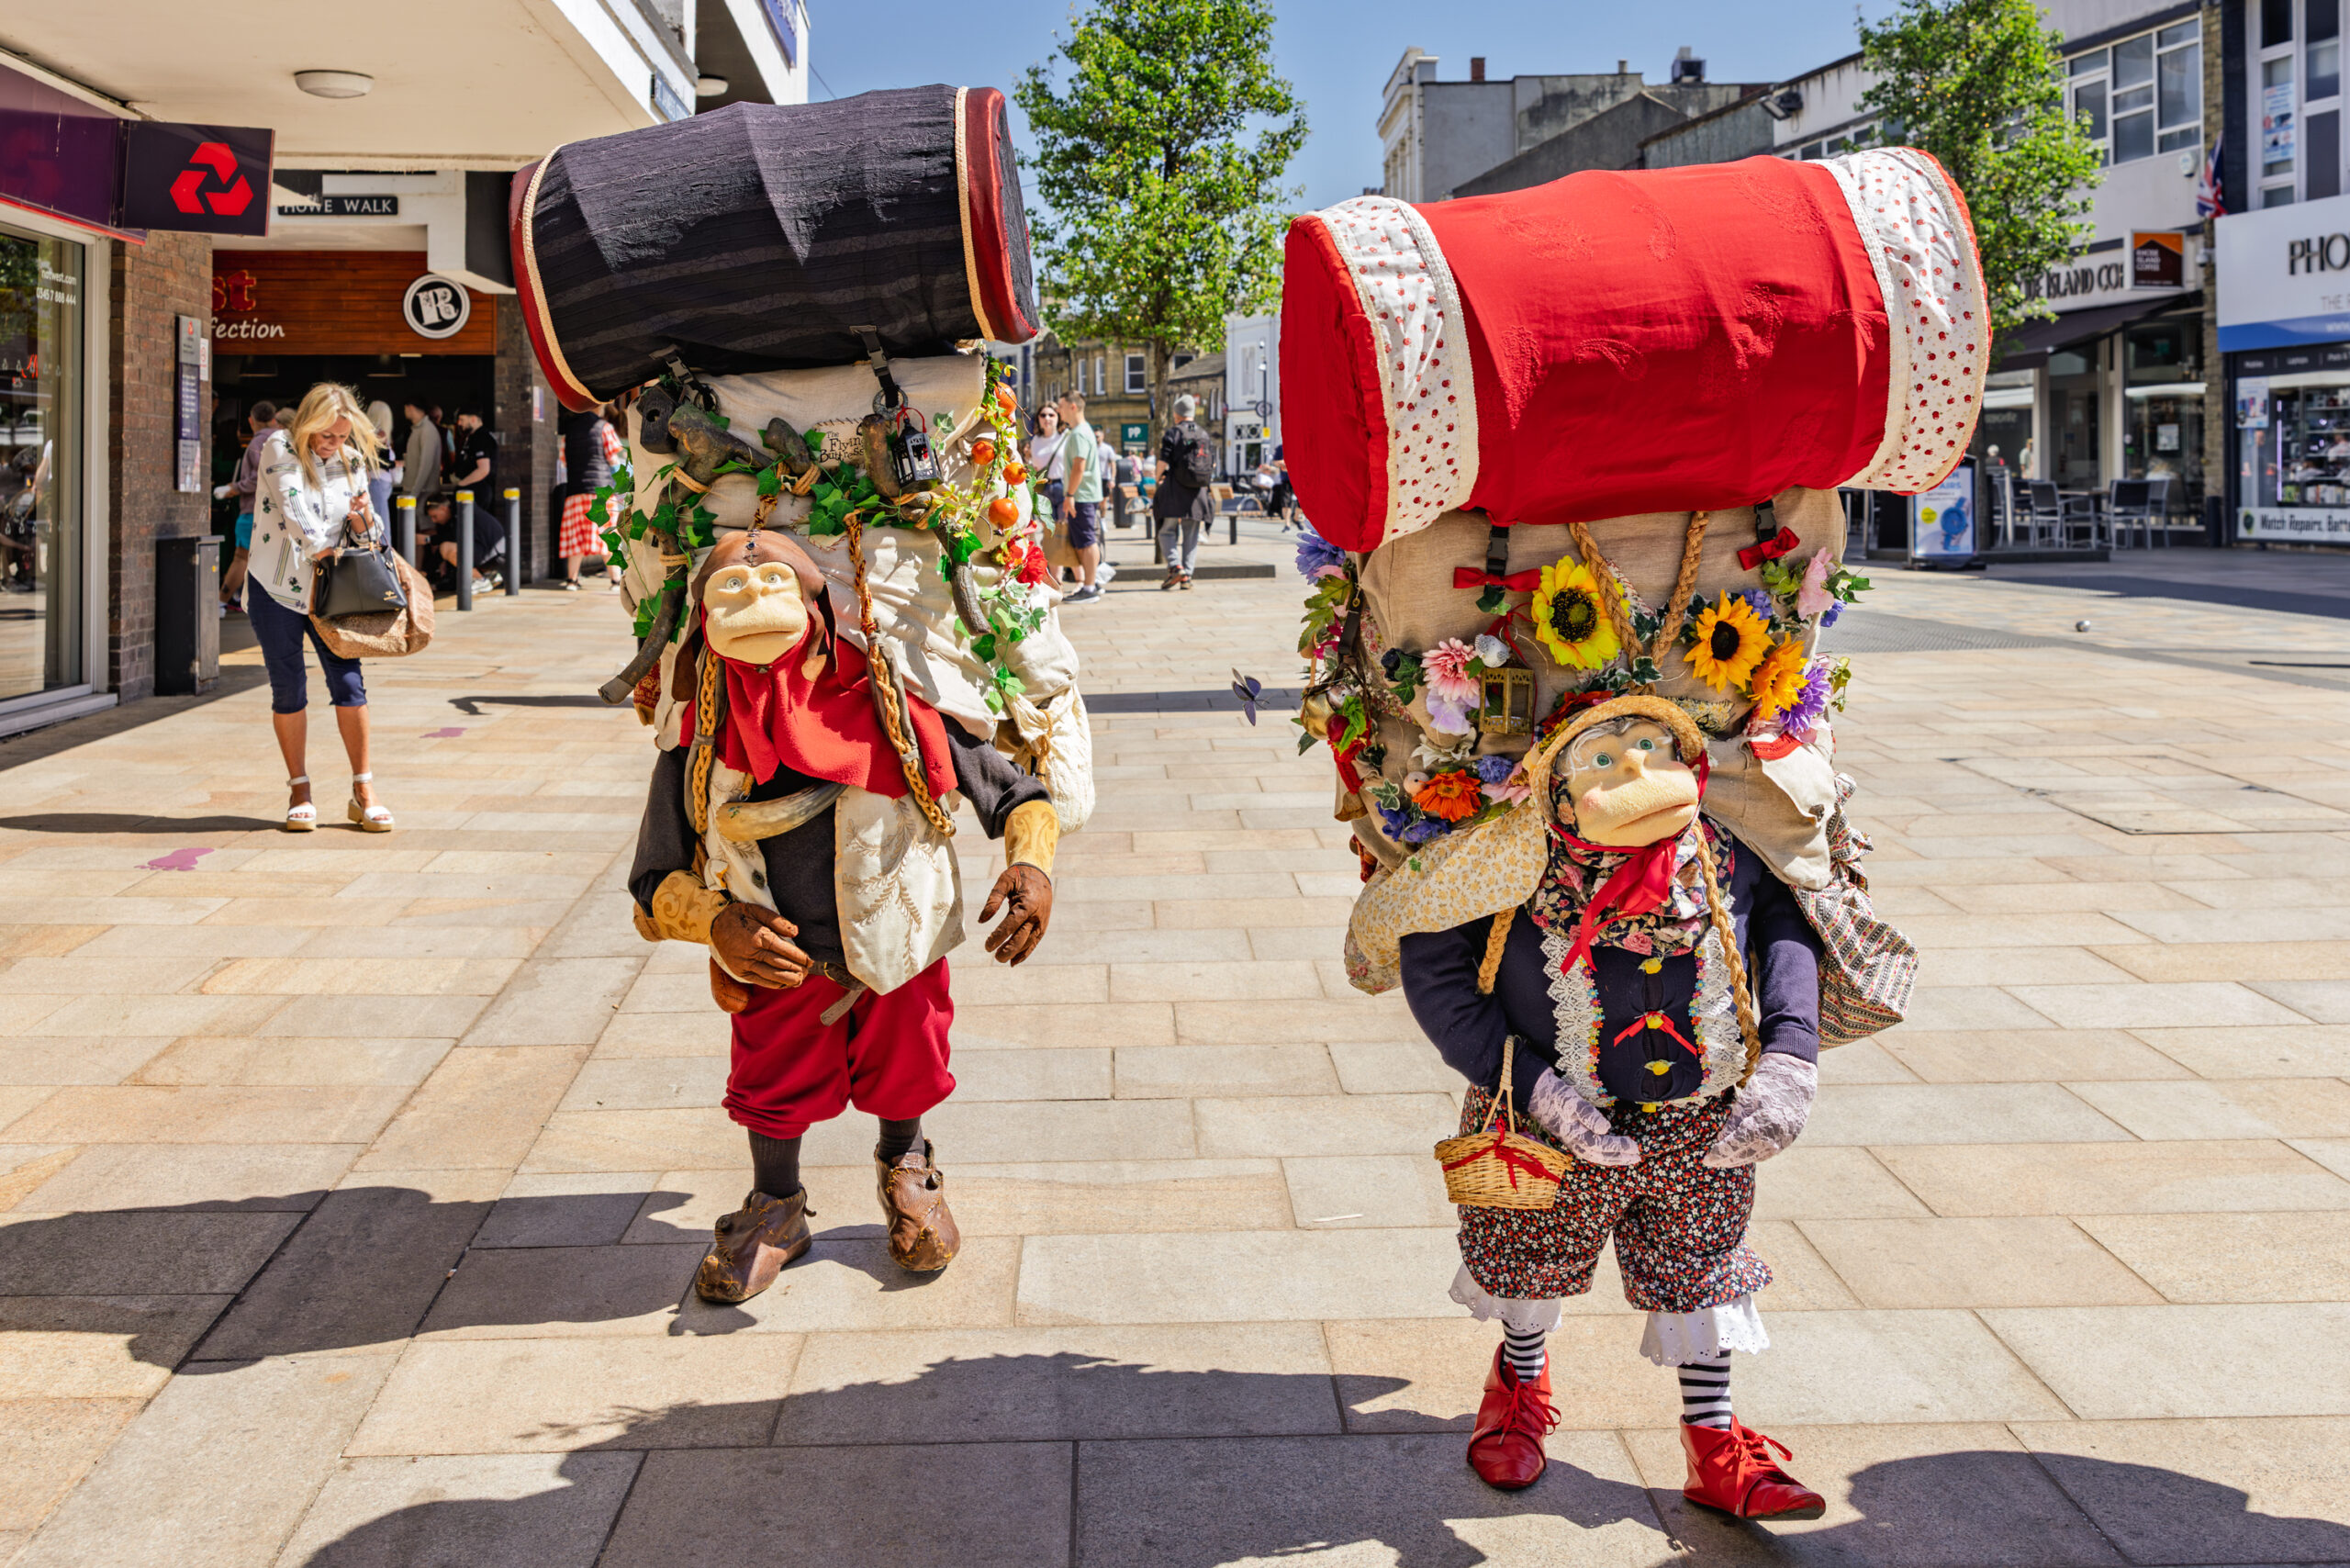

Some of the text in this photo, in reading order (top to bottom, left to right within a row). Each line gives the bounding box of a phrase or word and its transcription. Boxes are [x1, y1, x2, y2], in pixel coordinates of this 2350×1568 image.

[343, 199, 392, 213] WALK
[2046, 267, 2094, 299] ISLAND
[2322, 294, 2343, 311] THE
[2260, 514, 2286, 531] Watch
